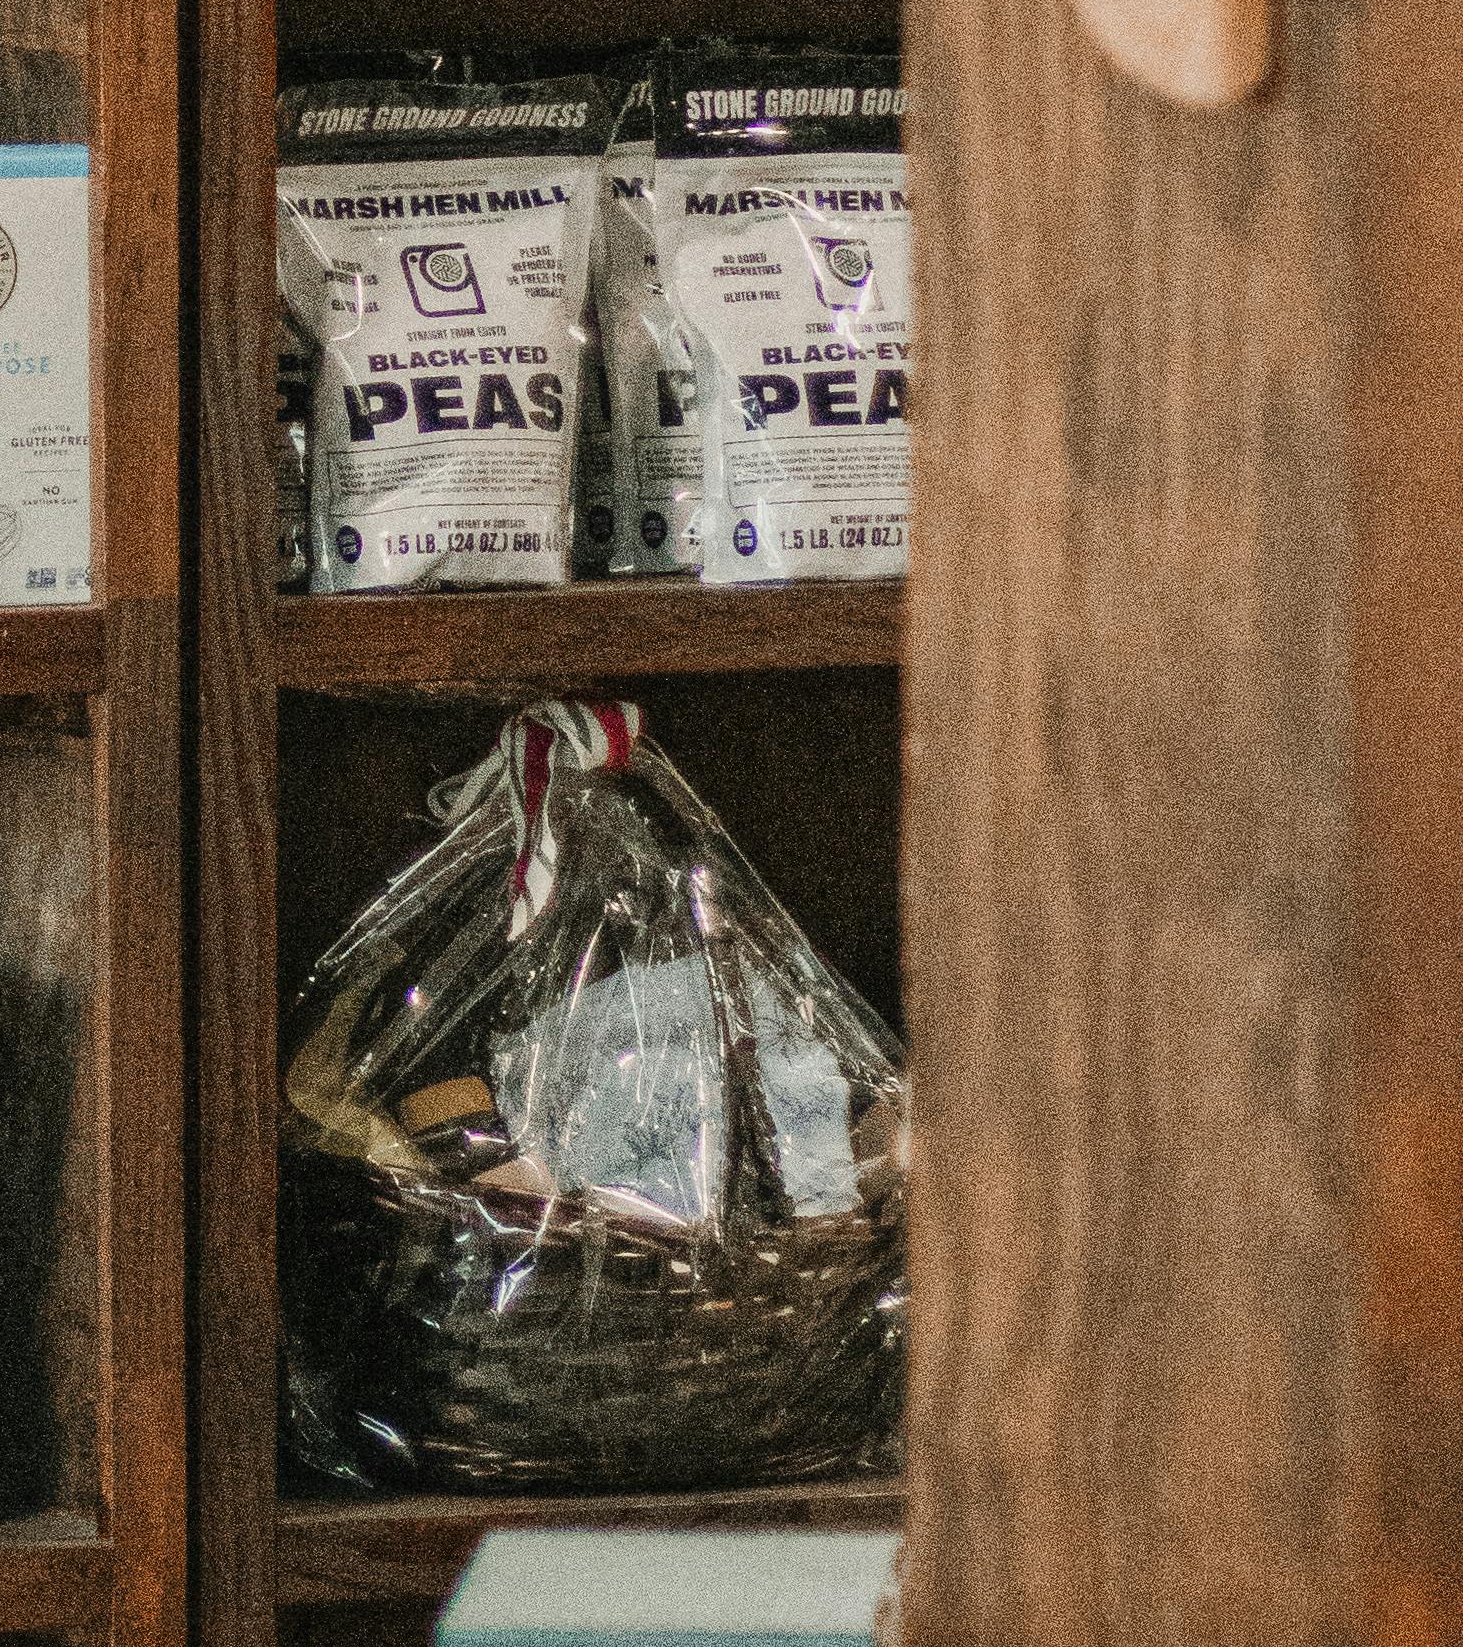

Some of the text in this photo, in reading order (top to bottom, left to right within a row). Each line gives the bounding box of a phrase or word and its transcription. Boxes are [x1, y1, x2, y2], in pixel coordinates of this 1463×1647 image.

[686, 90, 758, 120] STONE
[764, 88, 856, 118] GROUND
[300, 102, 588, 136] STONE GROUND GOODNESS
[411, 192, 483, 216] HEN
[815, 190, 885, 212] HEN
[368, 346, 548, 373] BLACK-EYED
[343, 372, 563, 442] PEAS
[10, 435, 89, 449] GLUTEN FREE
[42, 484, 60, 497] NO
[385, 532, 508, 556] 1.5 LB. (24 OZ.)
[810, 529, 834, 549] LB.
[840, 527, 866, 547] (24
[871, 527, 903, 547] OZ.)
